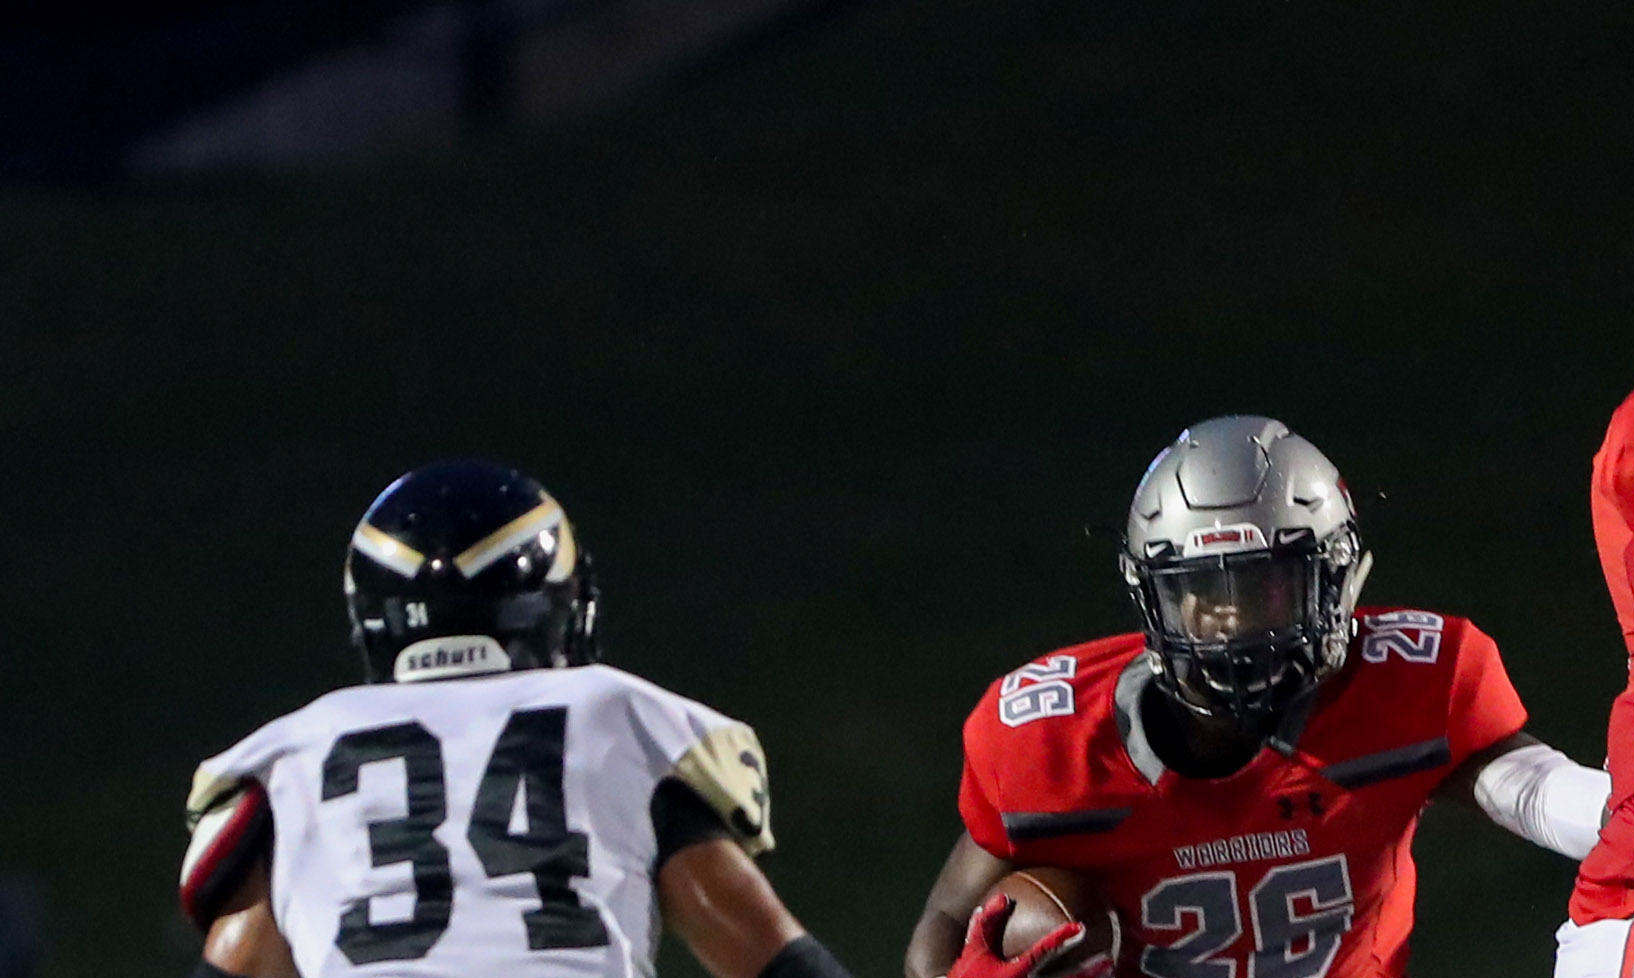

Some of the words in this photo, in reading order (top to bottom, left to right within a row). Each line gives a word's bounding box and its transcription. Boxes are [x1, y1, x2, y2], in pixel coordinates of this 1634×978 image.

[999, 654, 1077, 728] 26
[321, 705, 611, 967] 34
[1173, 829, 1310, 870] WARRIORS
